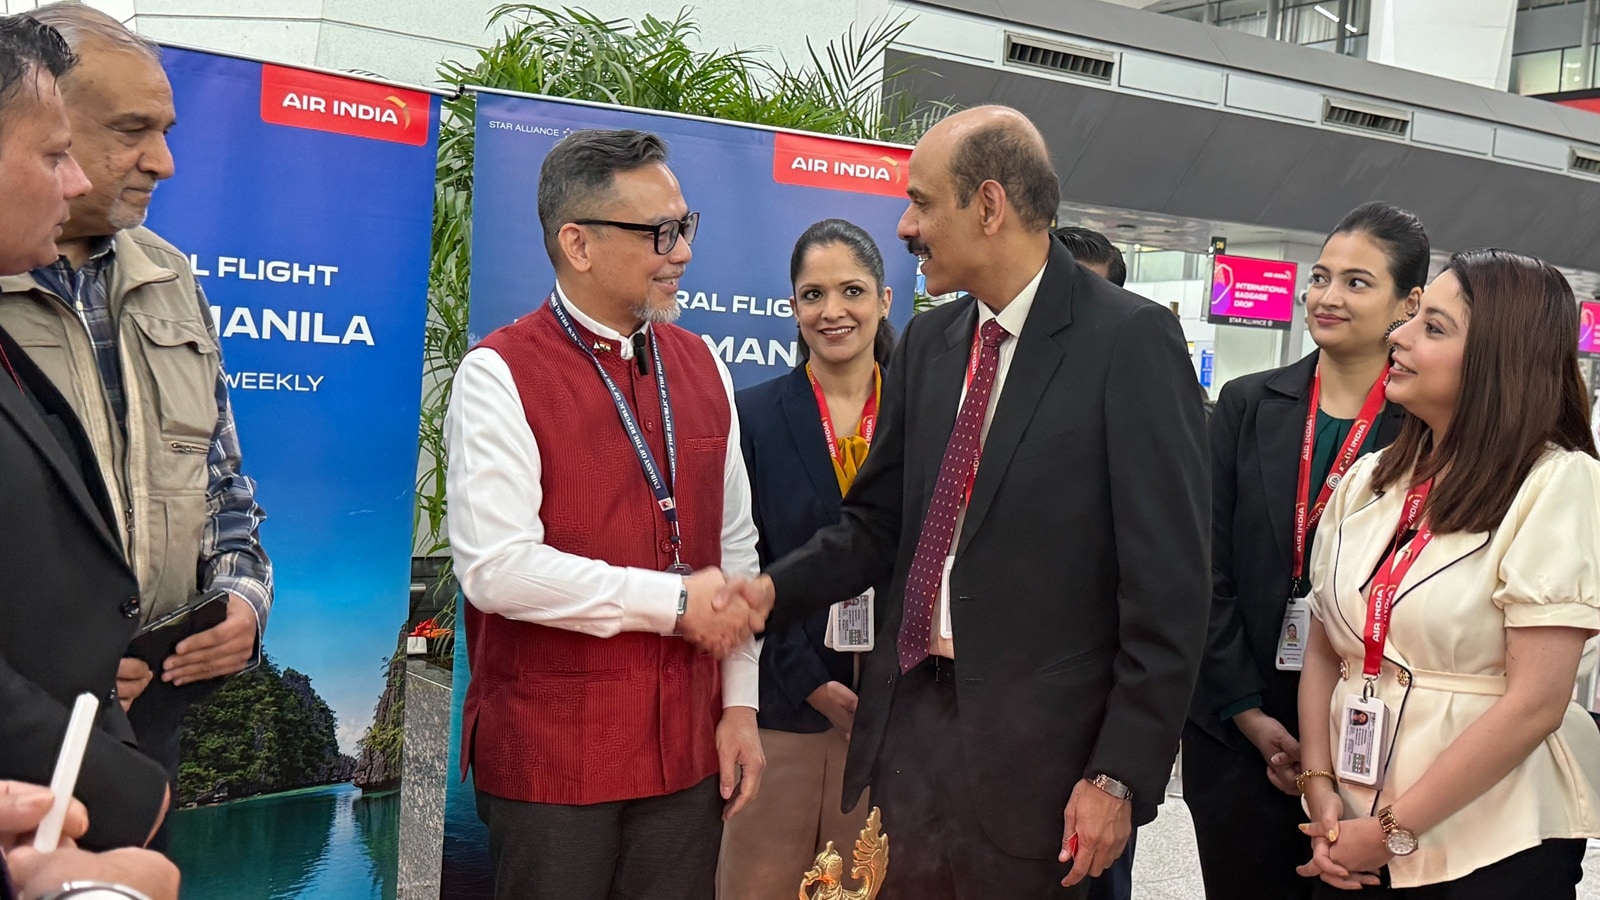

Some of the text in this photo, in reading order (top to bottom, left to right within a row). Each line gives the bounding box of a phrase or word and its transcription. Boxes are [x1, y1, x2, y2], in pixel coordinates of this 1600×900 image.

[282, 93, 398, 125] AIR INDIA
[489, 121, 560, 137] STAR ALLIANCE
[791, 157, 890, 181] AIR INDIA
[218, 256, 338, 286] FLIGHT
[1234, 291, 1269, 301] BAGGAGE
[1235, 282, 1289, 294] INTERNATIONAL
[1233, 300, 1255, 308] DROP
[619, 401, 637, 435] REPUBLIC
[865, 418, 873, 442] INDIA
[632, 434, 643, 451] THE
[822, 420, 837, 458] AIR INDIA
[1302, 418, 1313, 461] AIR INDIA
[1350, 424, 1367, 448] INDIA
[643, 459, 661, 489] EMBASSY
[1297, 506, 1305, 533] INDIA
[1407, 499, 1421, 526] INDIA
[1372, 589, 1384, 643] AIR INDIA
